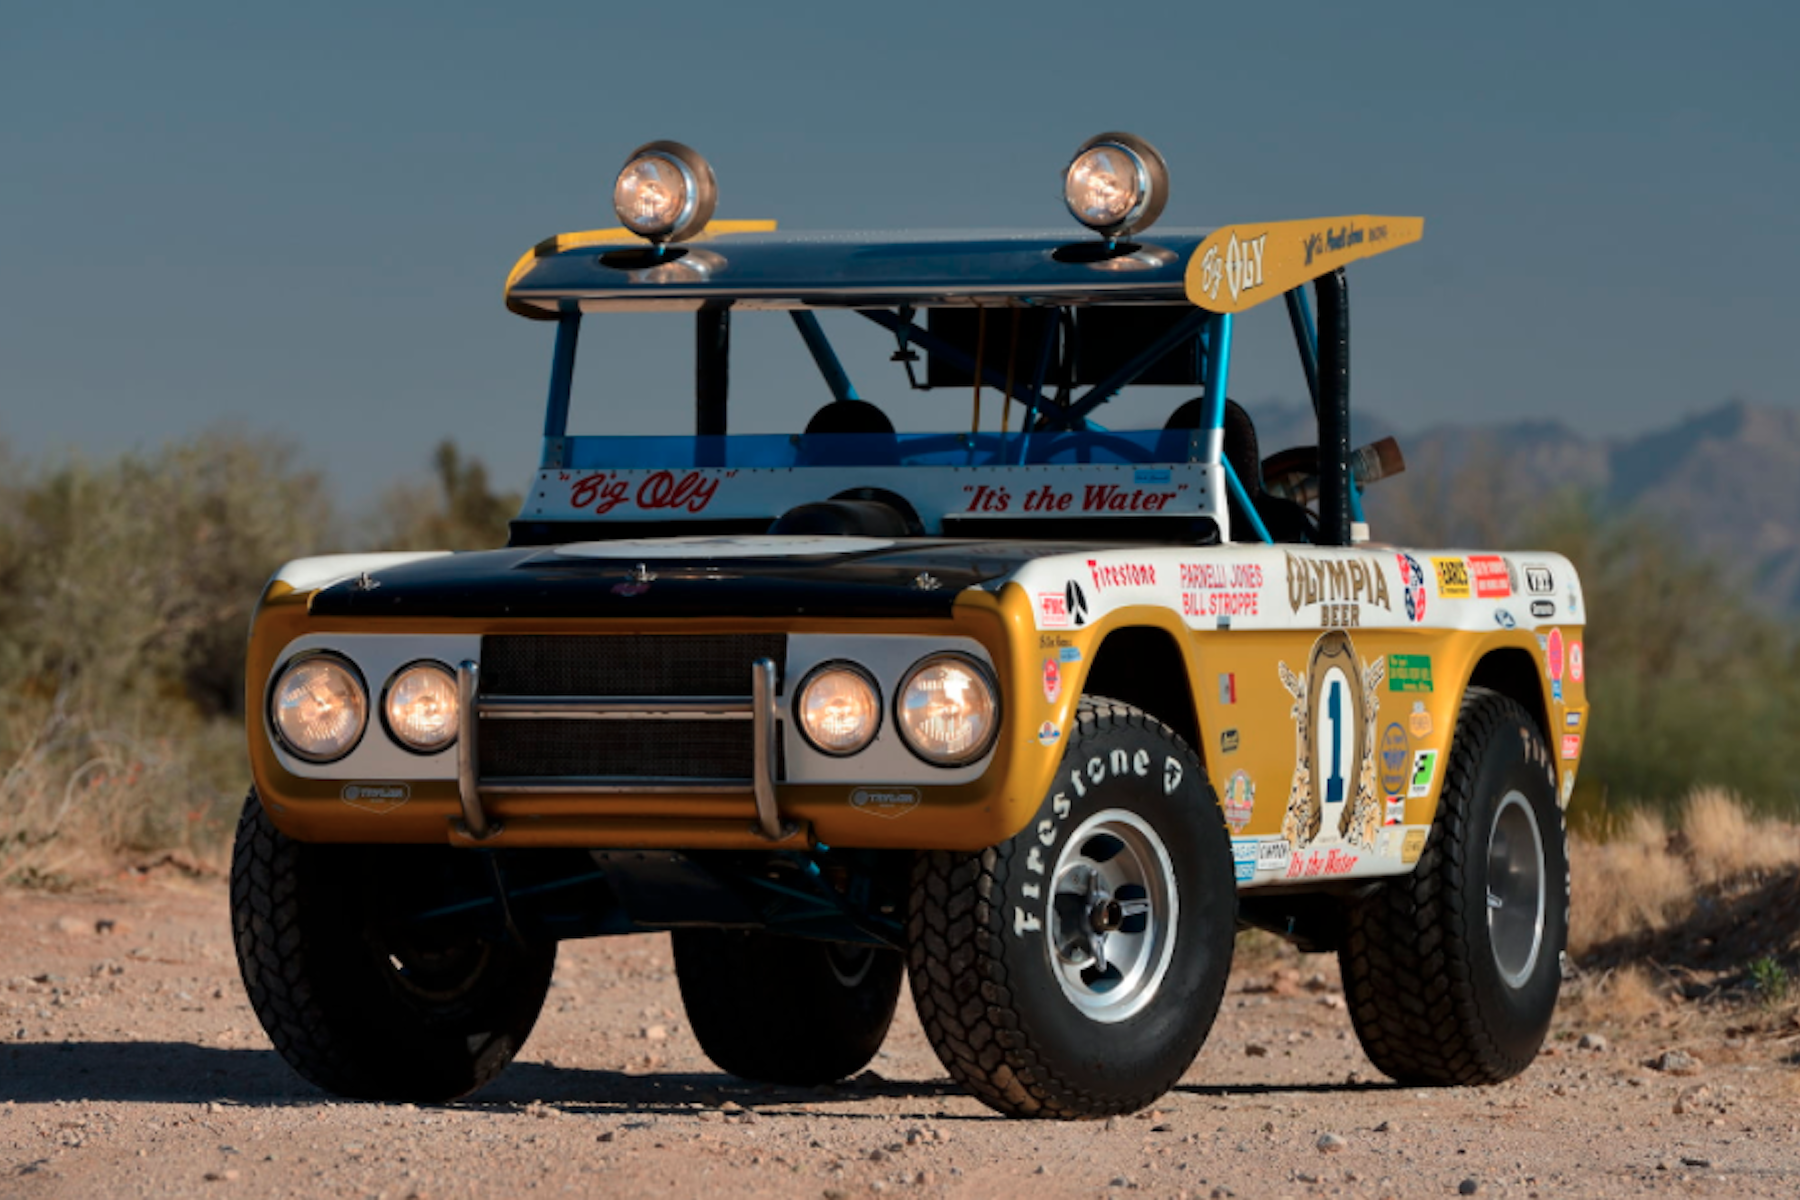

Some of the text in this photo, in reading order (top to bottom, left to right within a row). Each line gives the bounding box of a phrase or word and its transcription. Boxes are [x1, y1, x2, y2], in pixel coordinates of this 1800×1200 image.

[1225, 230, 1268, 305] OLY
[1023, 485, 1074, 511] the
[1082, 484, 1189, 511] Water"
[1087, 560, 1156, 592] Firestone
[1180, 564, 1263, 588] PARNELLI JONES
[1283, 549, 1391, 615] OLYMPIA
[1182, 592, 1258, 616] BILL STROPPE
[1320, 604, 1359, 627] BEER
[1325, 680, 1344, 803] 1
[1014, 748, 1151, 937] Firestone
